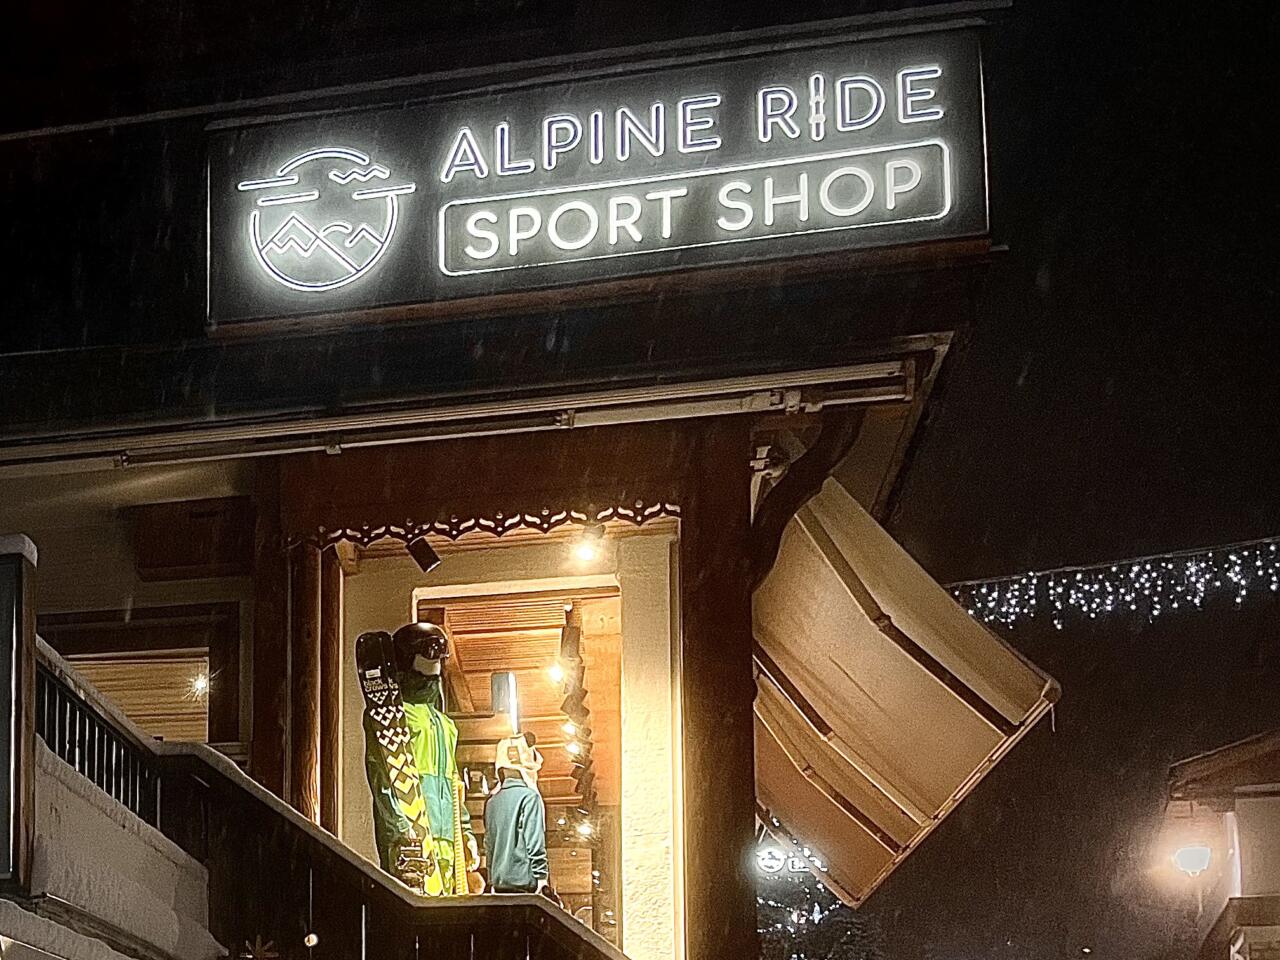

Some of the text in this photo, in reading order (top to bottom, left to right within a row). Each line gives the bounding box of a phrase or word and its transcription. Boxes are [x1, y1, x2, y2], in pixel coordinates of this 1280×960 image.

[440, 65, 945, 182] ALPINE RIDE
[464, 158, 923, 260] SPORT SHOP
